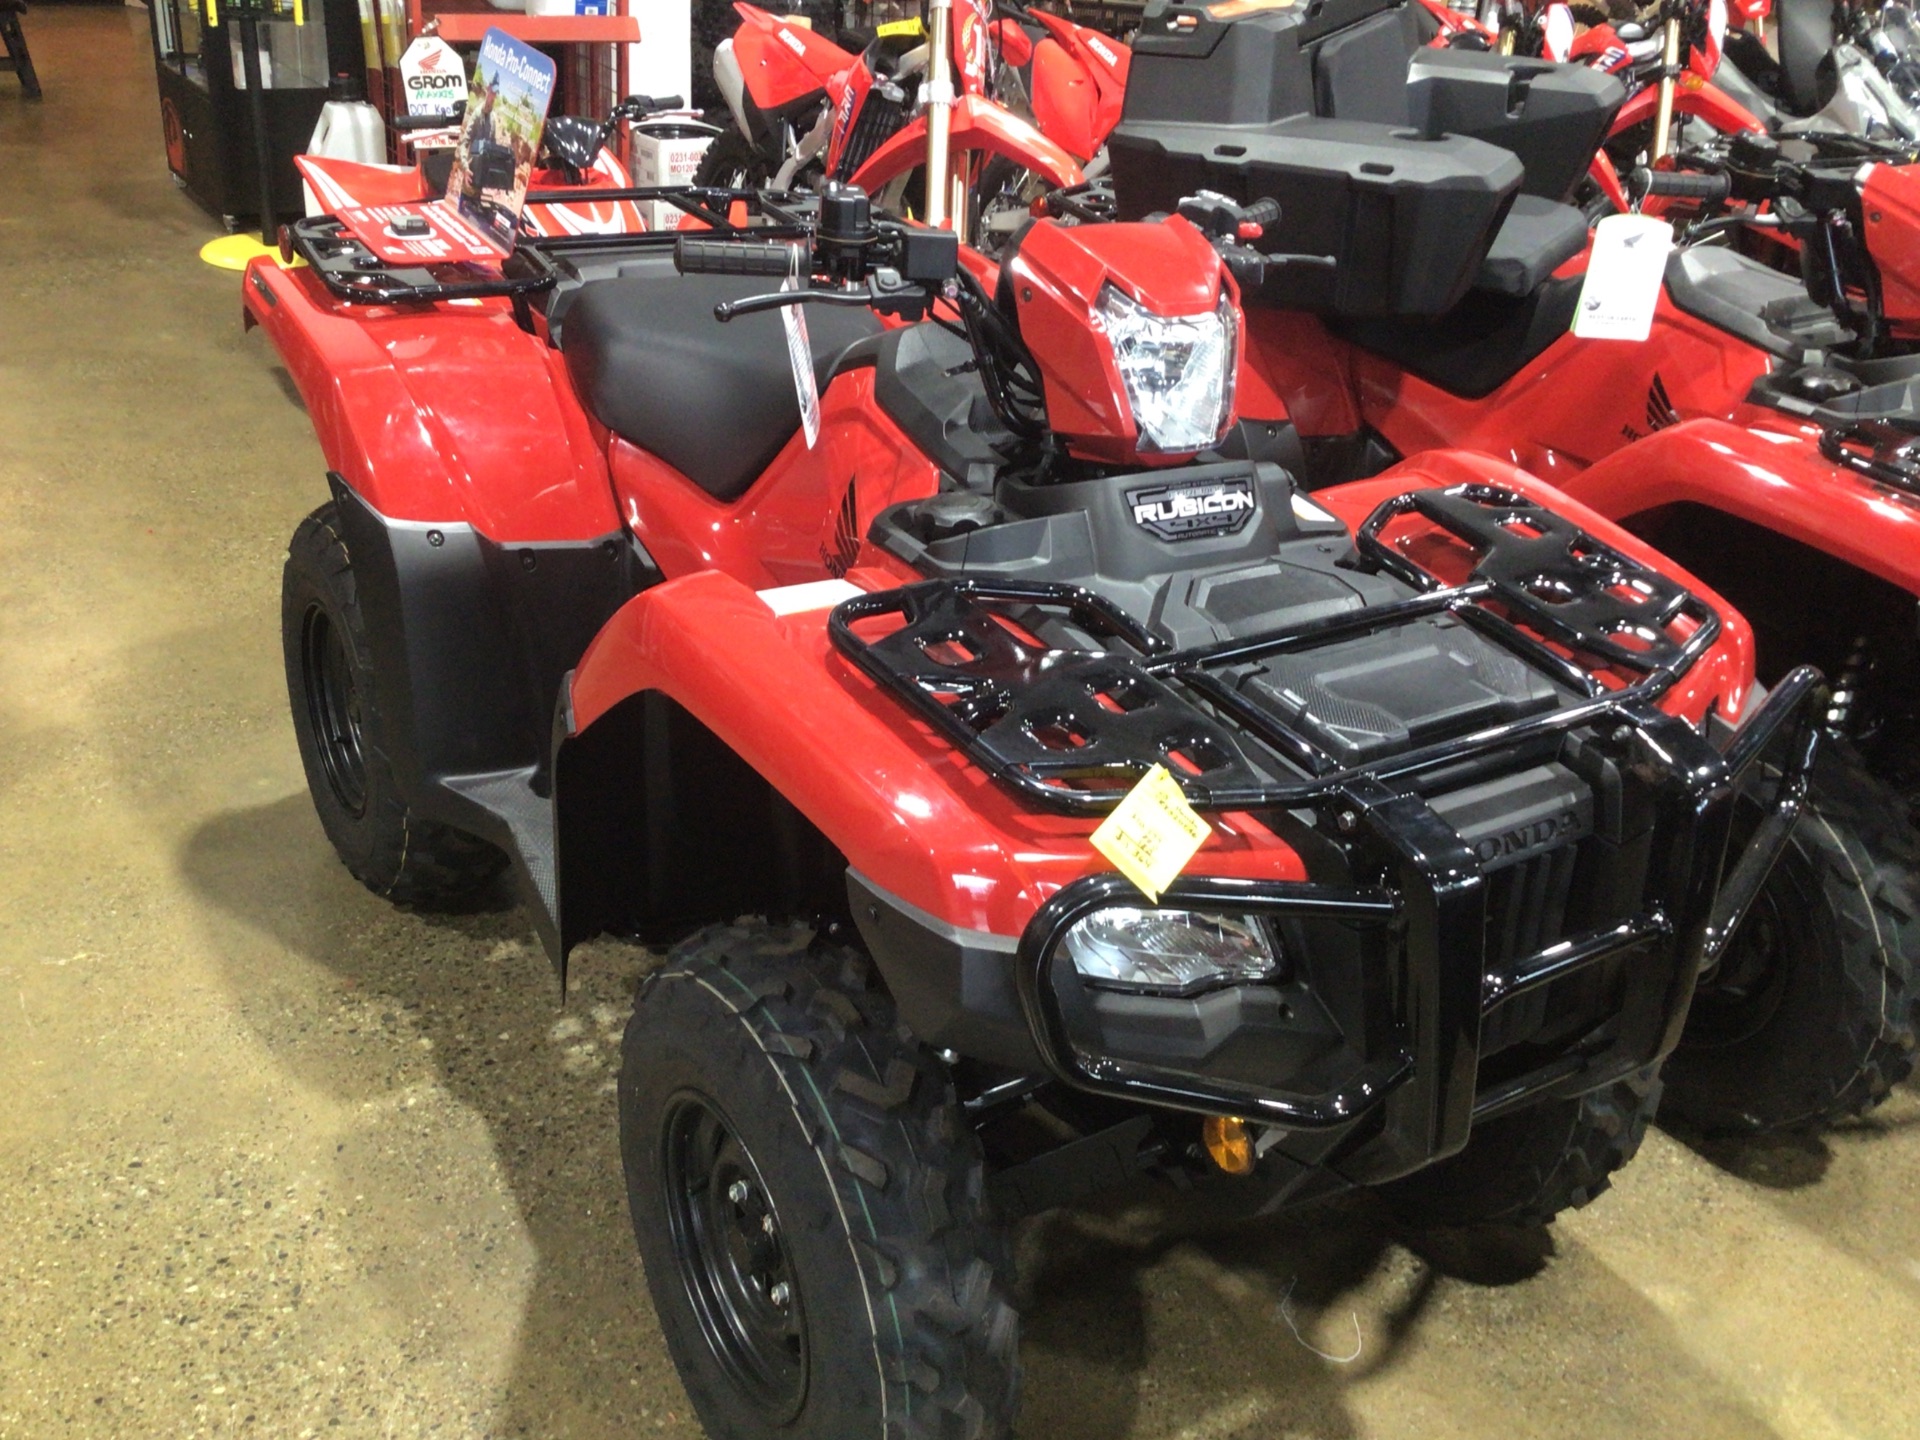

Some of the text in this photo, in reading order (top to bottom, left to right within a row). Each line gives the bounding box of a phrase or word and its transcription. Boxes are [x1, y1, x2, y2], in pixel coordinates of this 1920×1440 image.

[483, 34, 551, 94] Honda Pro-Connect
[408, 75, 462, 90] GROM
[410, 104, 428, 116] DOT
[1134, 490, 1254, 524] RUBICON
[1475, 811, 1581, 861] ONDA
